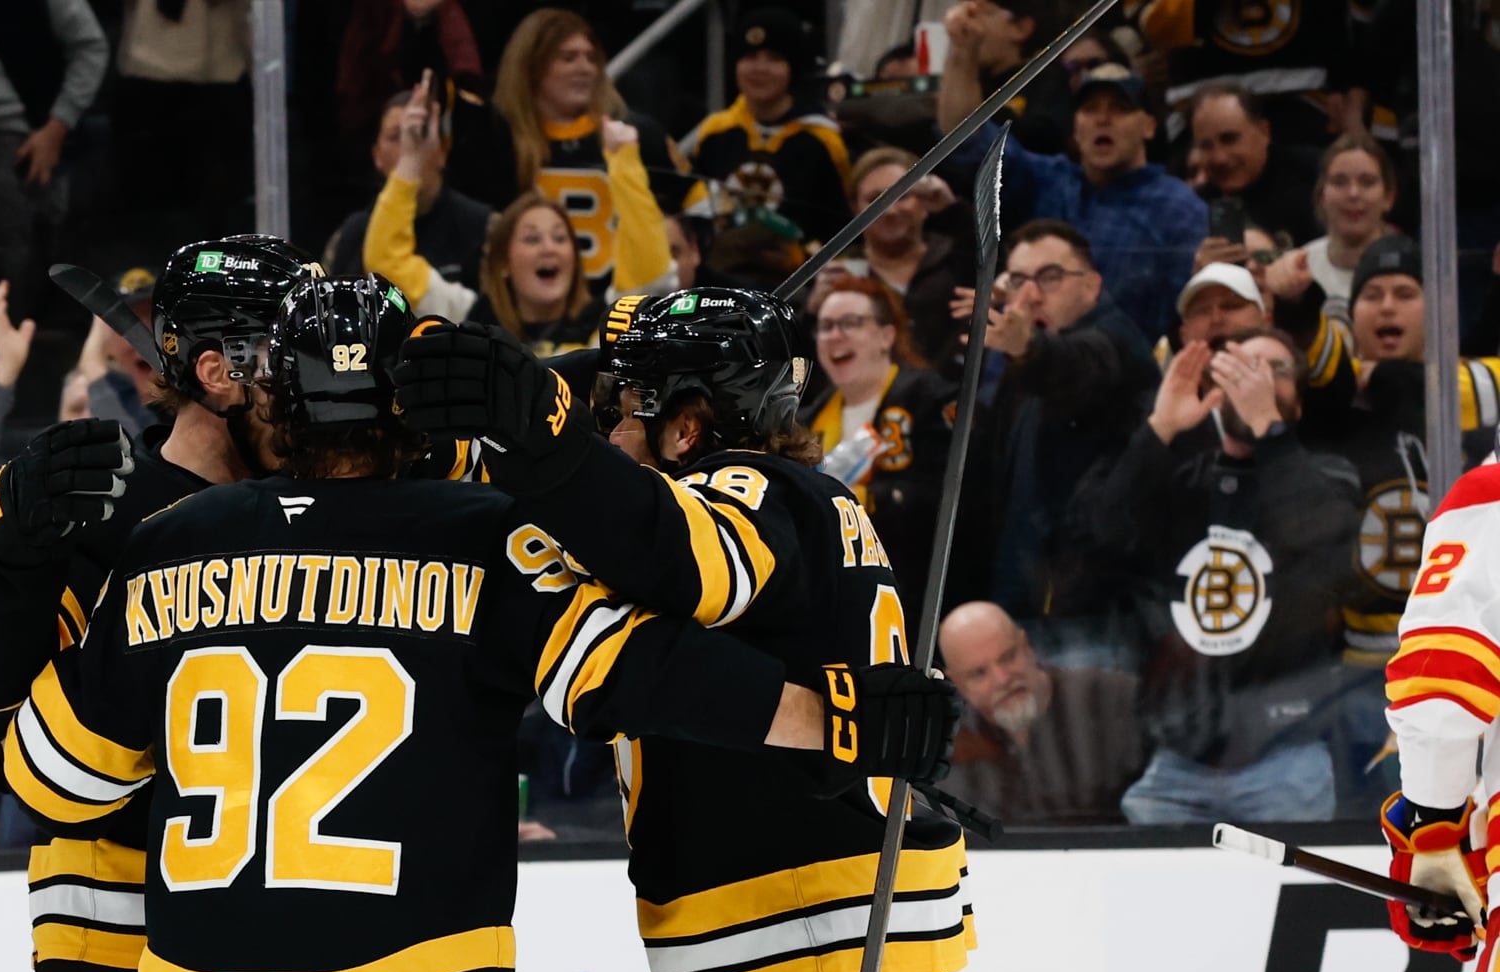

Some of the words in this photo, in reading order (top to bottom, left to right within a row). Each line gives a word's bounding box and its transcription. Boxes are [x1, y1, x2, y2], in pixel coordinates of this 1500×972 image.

[201, 254, 220, 269] TD
[224, 257, 260, 271] Bank
[700, 298, 737, 308] Bank
[332, 343, 367, 372] 92
[125, 555, 485, 646] KHUSNUTDINOV
[822, 663, 858, 763] CC
[160, 645, 417, 895] 92
